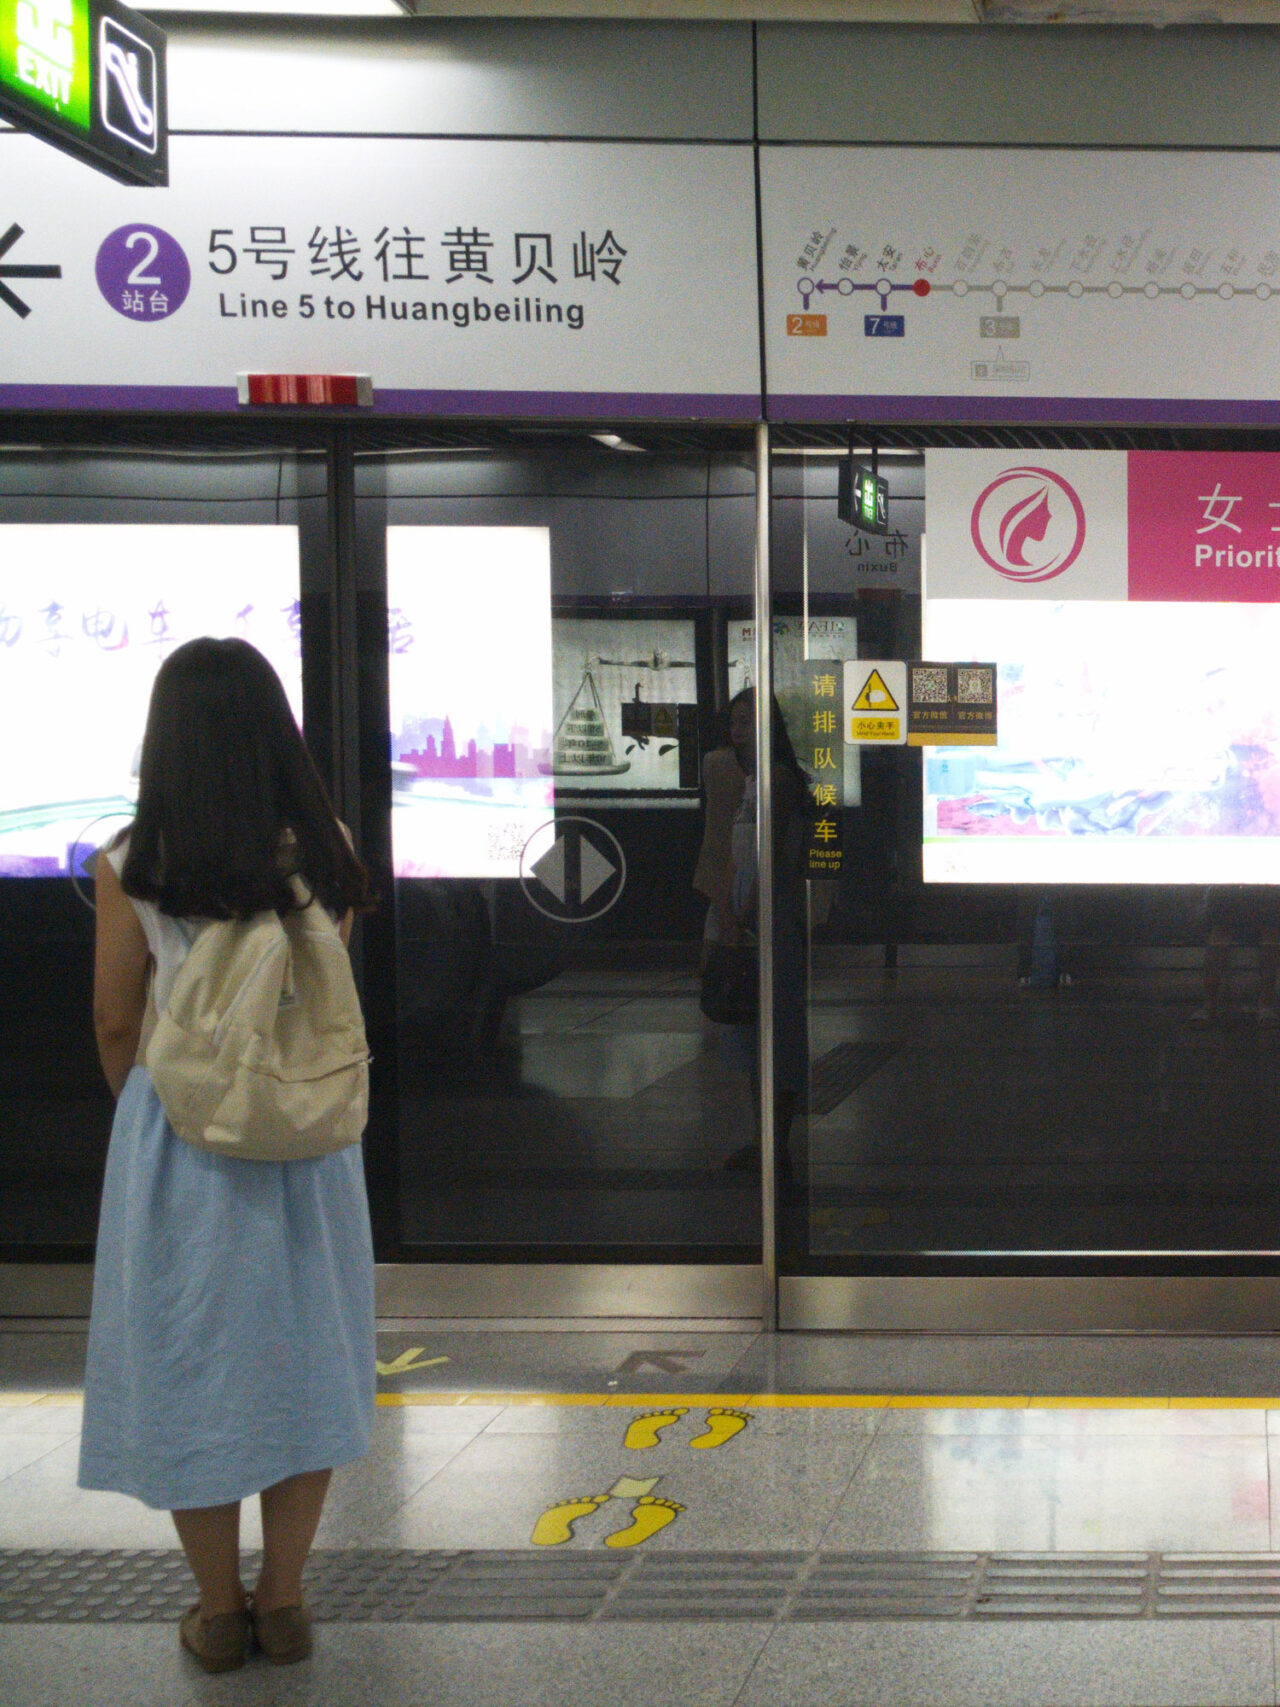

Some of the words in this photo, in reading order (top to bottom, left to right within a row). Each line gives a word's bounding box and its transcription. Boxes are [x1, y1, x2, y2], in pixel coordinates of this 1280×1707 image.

[16, 44, 74, 105] EXIT
[124, 232, 162, 286] 2
[208, 226, 629, 286] 5号线往黄贝岭
[122, 288, 171, 314] 站台
[219, 292, 289, 320] Line
[298, 294, 316, 321] 5
[325, 296, 356, 322] to
[365, 296, 586, 329] Huangbeiling
[811, 673, 838, 842] 请排队候车
[808, 848, 843, 860] Please
[808, 859, 829, 869] line
[830, 861, 842, 871] up
